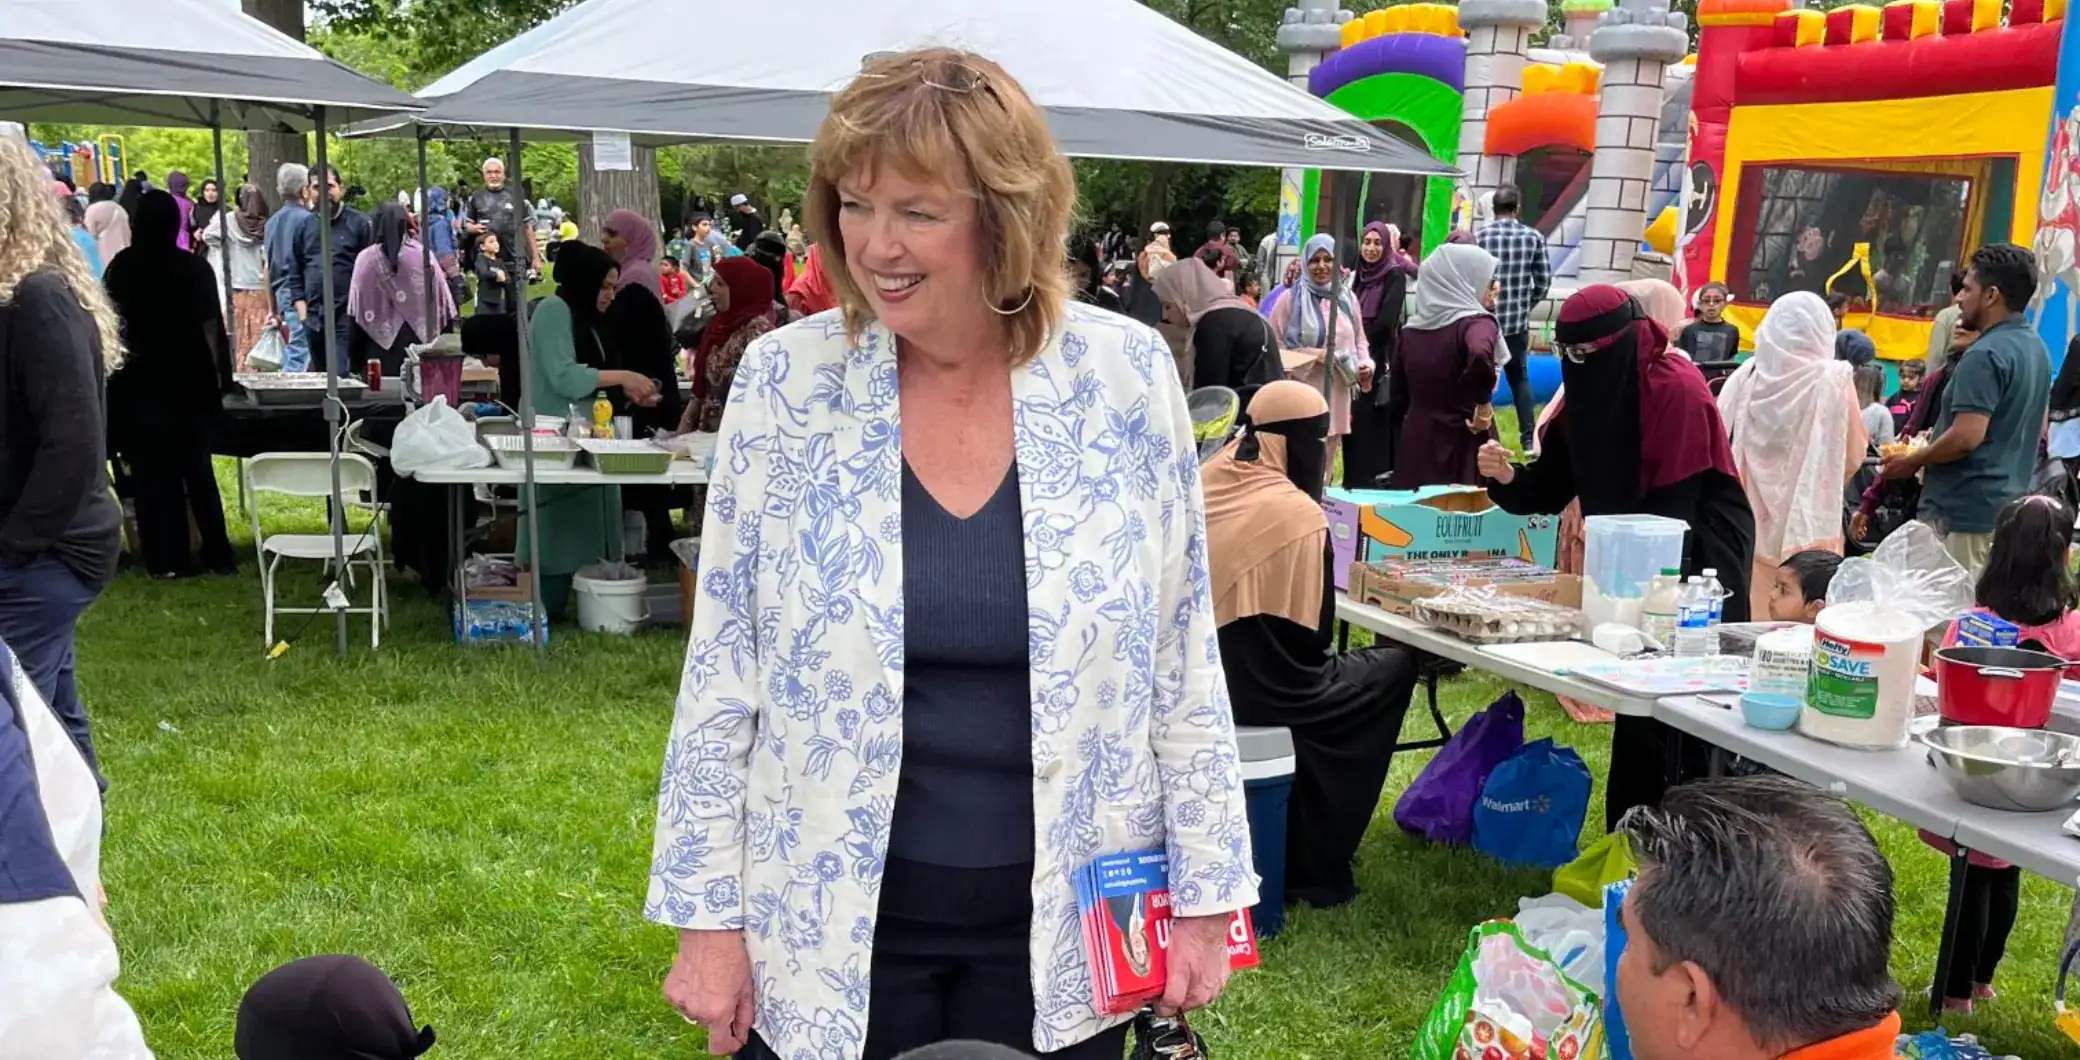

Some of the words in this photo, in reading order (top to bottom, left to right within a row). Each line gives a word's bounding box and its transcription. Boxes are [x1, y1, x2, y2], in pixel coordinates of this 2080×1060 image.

[1436, 515, 1483, 538] EQUIFRUIT
[1407, 550, 1428, 559] THE
[1431, 550, 1458, 559] ONLY
[1821, 639, 1849, 655] Hefty
[1483, 796, 1529, 812] Walmart
